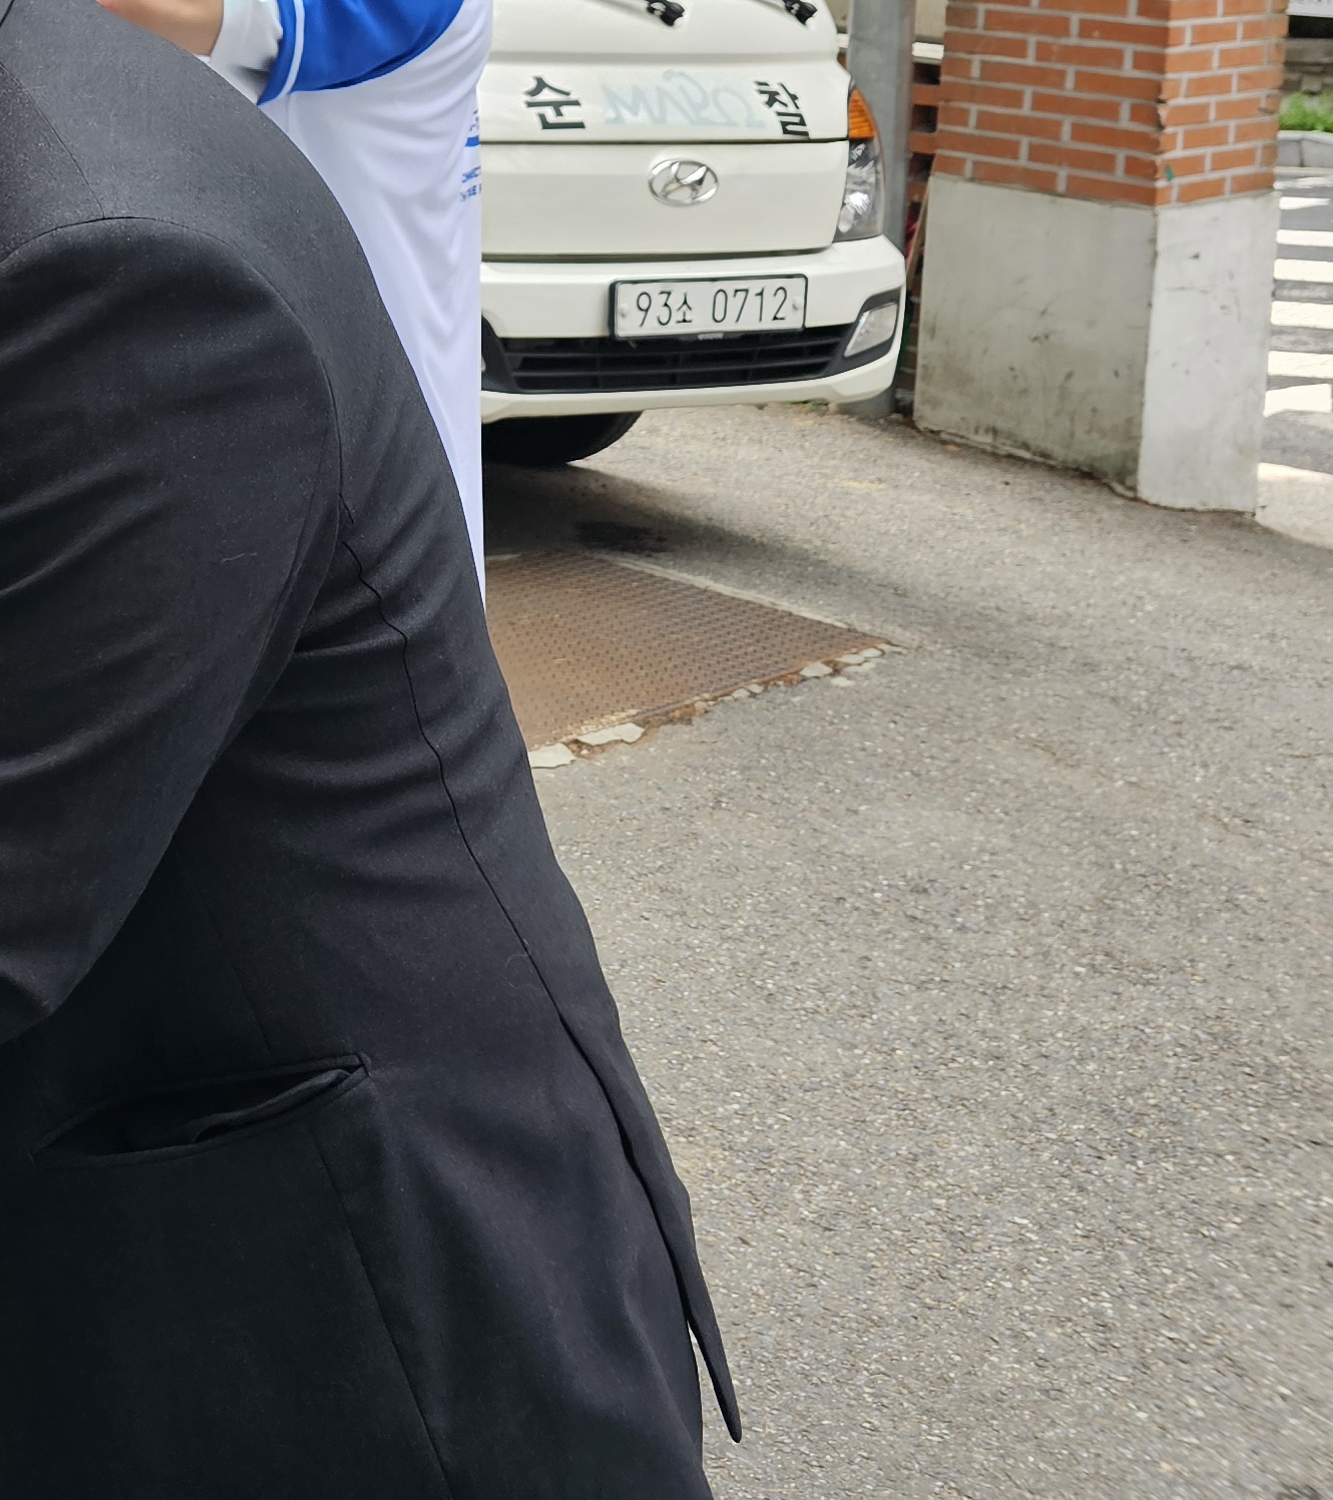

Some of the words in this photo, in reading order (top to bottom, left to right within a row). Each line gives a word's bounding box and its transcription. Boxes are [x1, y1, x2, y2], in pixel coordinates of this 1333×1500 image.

[524, 76, 586, 131] 순
[755, 80, 811, 138] 찰
[635, 289, 693, 327] 93소
[710, 285, 790, 325] 0712
